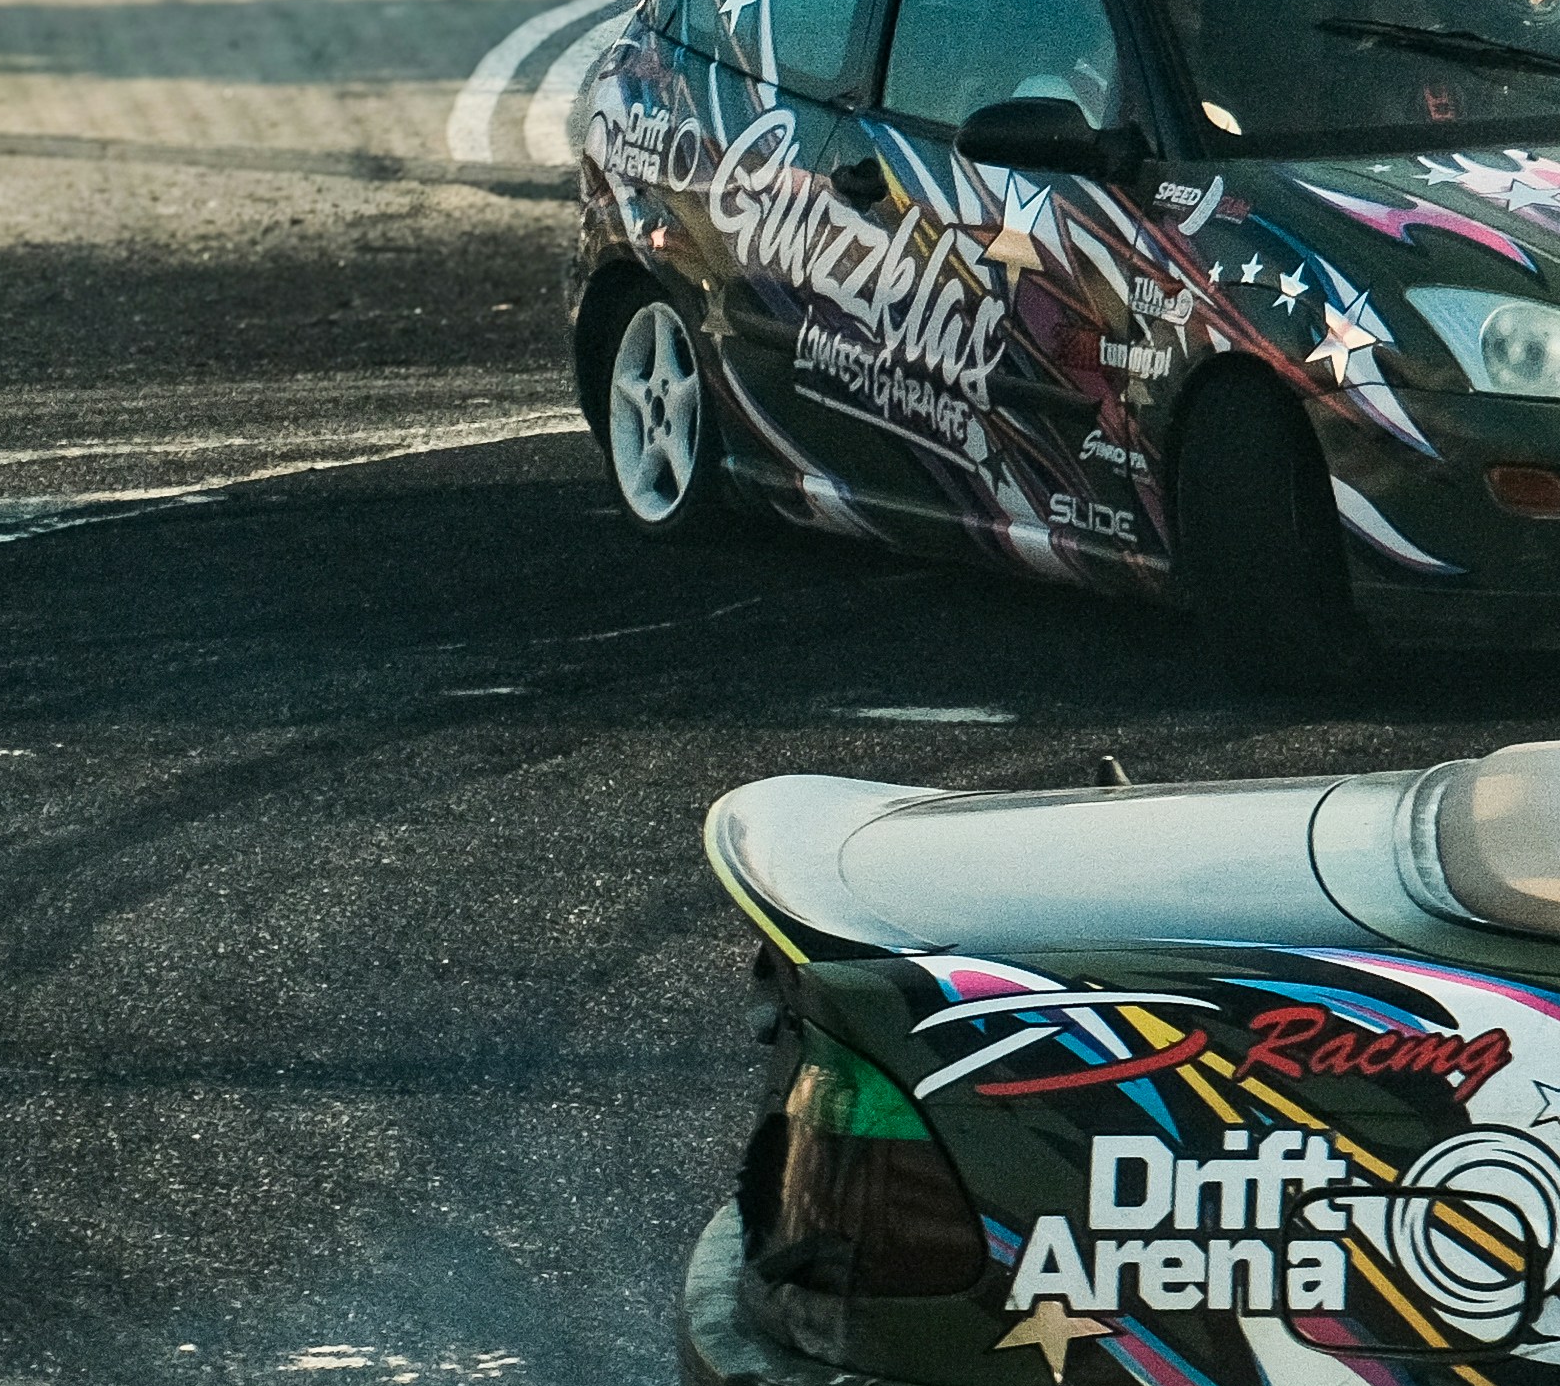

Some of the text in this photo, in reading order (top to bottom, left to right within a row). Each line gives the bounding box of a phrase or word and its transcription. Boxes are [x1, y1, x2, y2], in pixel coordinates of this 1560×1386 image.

[1155, 181, 1202, 206] SPEED
[1049, 492, 1138, 543] SLIDE
[1089, 1129, 1348, 1232] Drift
[1005, 1215, 1348, 1312] Arena
